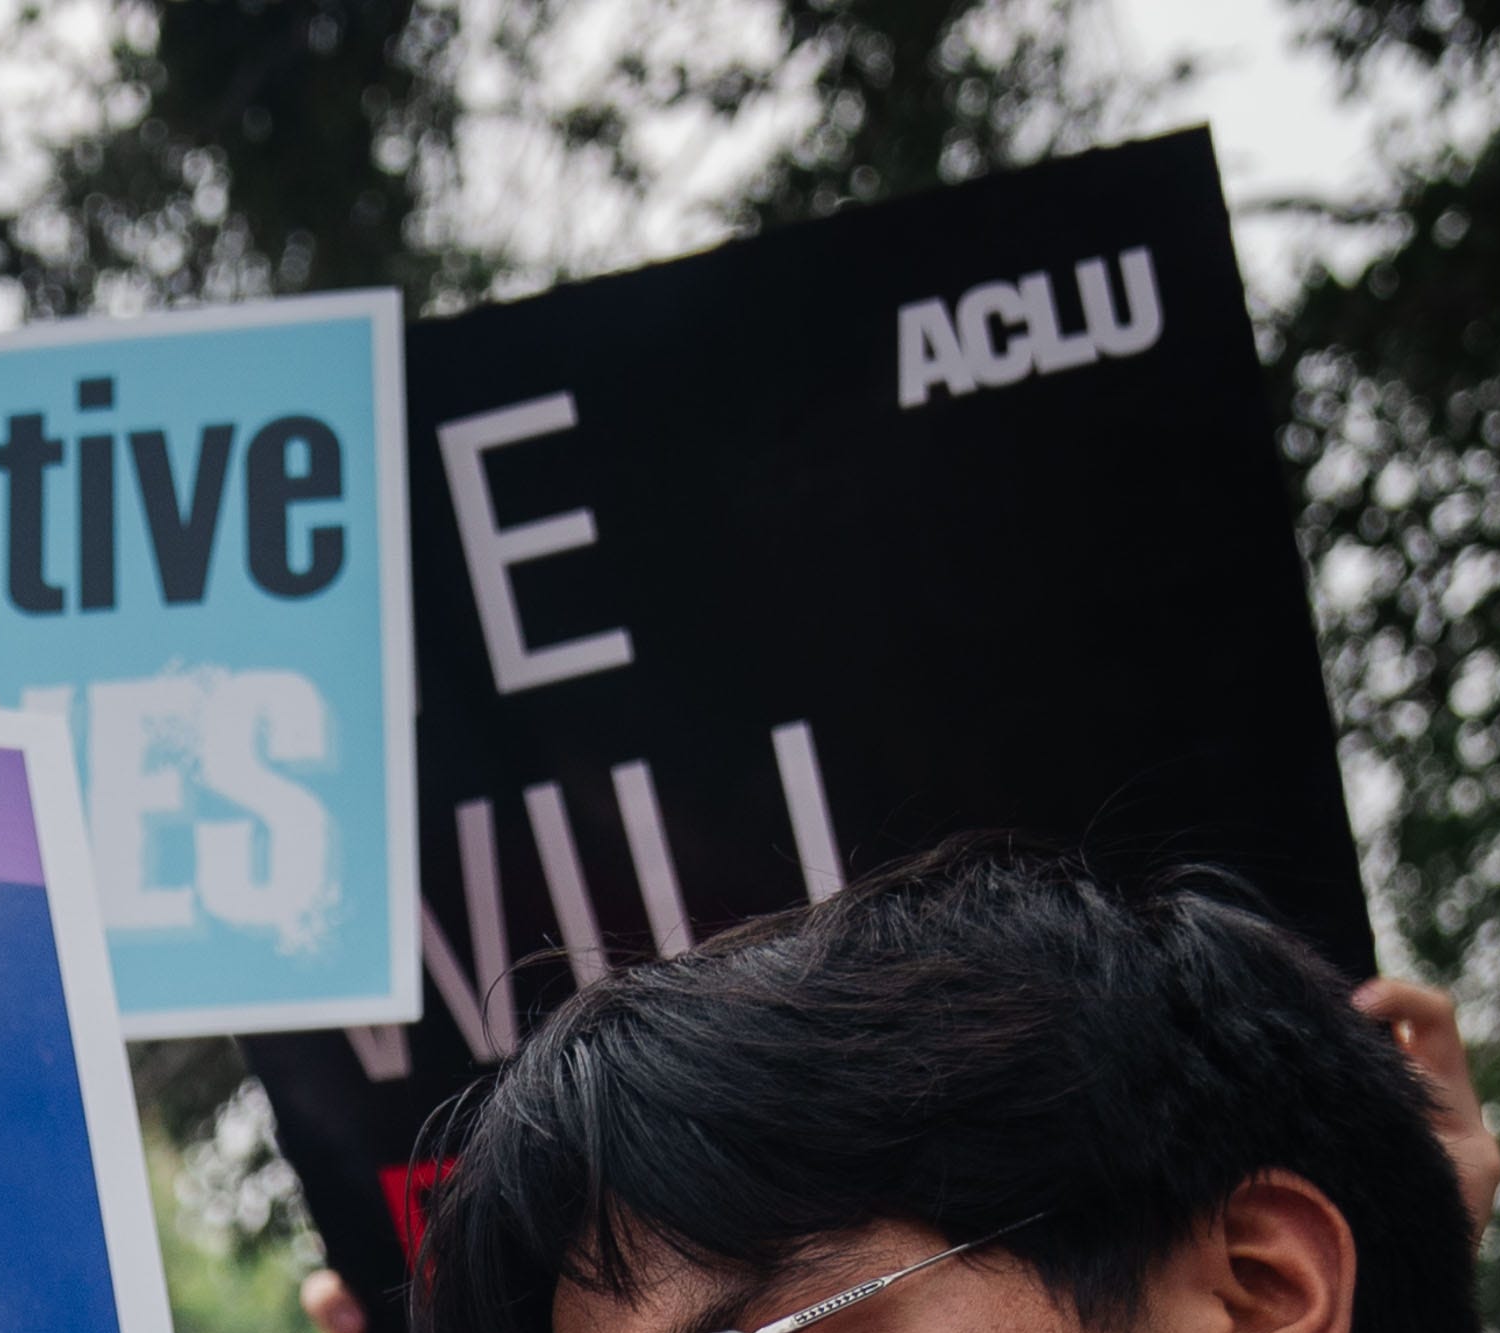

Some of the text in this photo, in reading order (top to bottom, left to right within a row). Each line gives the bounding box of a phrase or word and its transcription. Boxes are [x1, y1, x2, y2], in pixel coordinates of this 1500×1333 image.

[897, 245, 1163, 408] ACLU
[436, 391, 635, 695] E
[22, 655, 343, 956] ES
